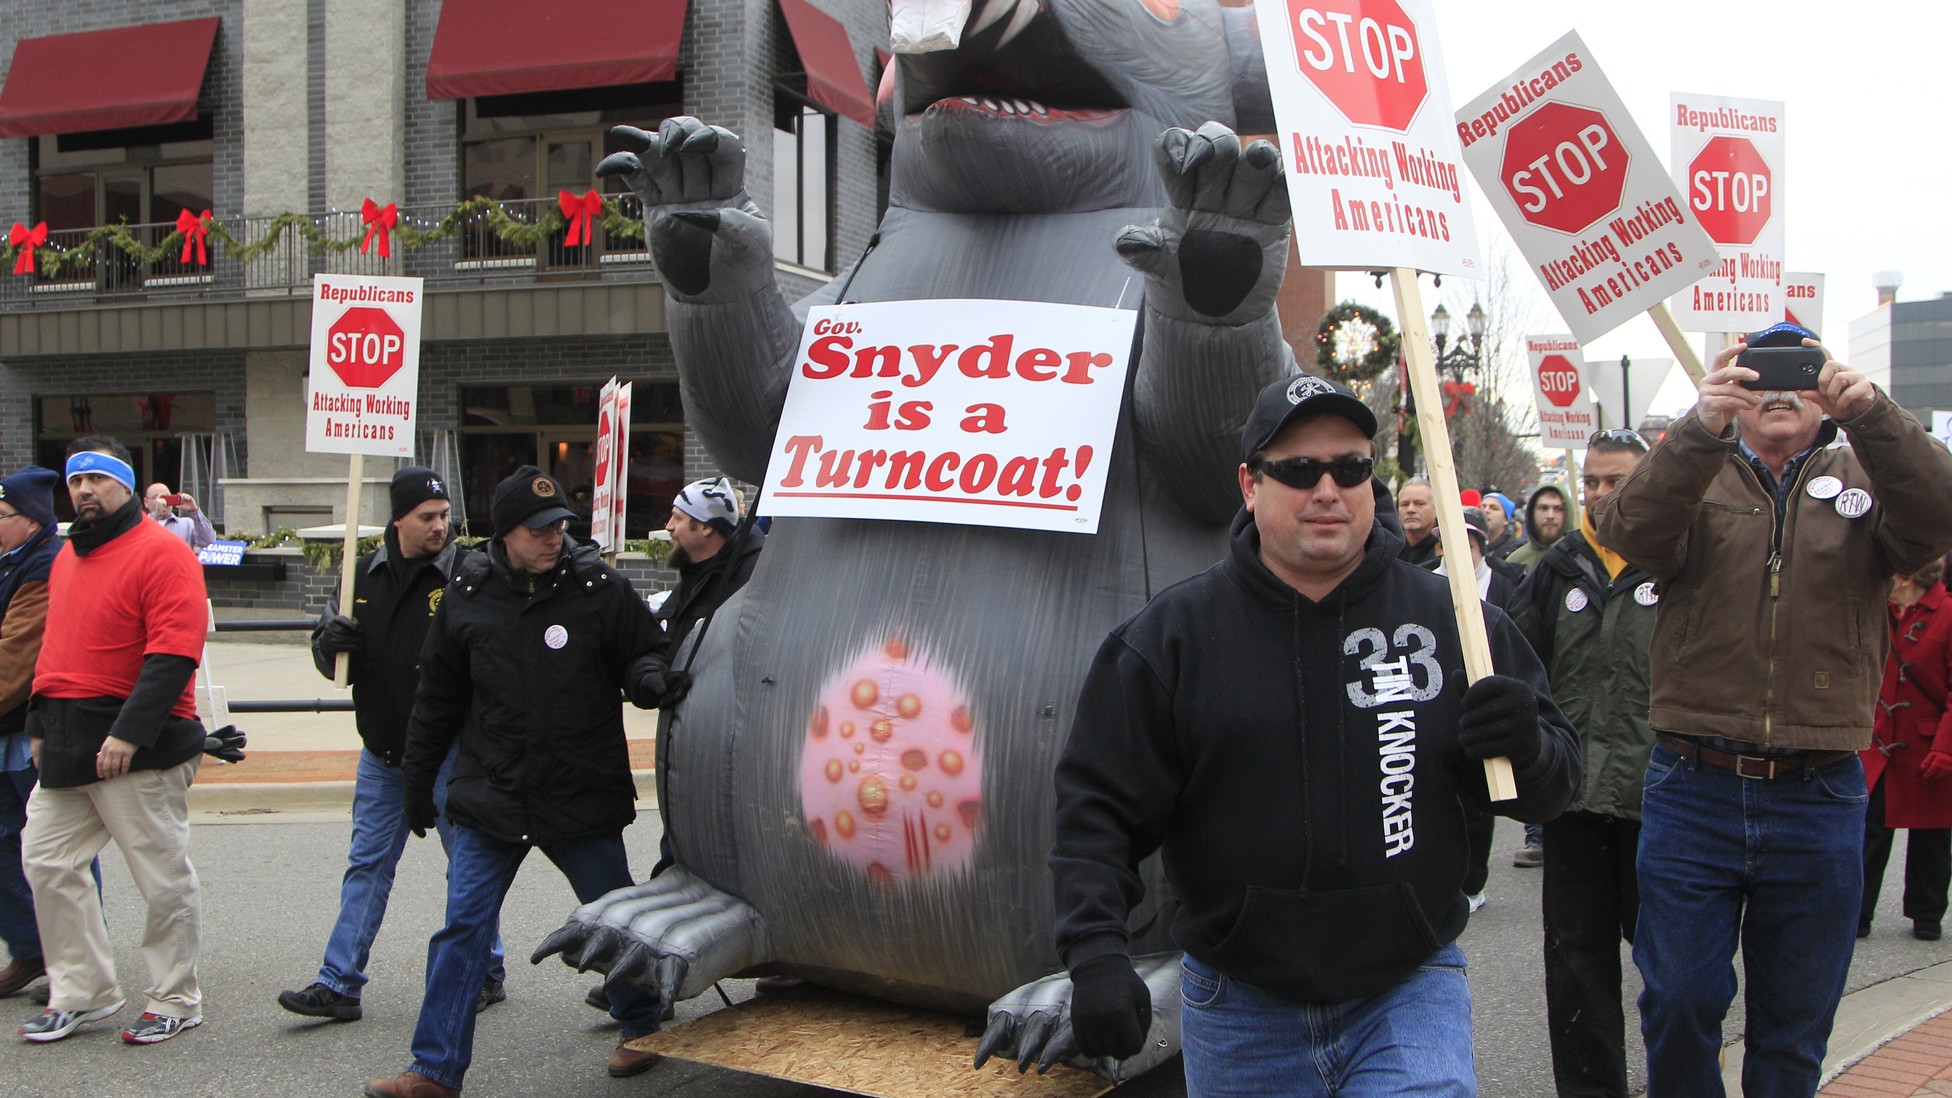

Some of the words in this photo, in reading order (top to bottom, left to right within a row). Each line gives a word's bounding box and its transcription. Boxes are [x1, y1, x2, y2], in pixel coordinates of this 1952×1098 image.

[1298, 8, 1414, 84] STOP
[1456, 52, 1583, 148] Republicans
[1677, 103, 1777, 133] Republicans
[1292, 132, 1394, 190] Attacking
[1392, 141, 1461, 204] Working
[1512, 123, 1609, 213] STOP
[1693, 170, 1768, 213] STOP
[1331, 188, 1450, 243] Americans
[1539, 239, 1621, 292] Attacking
[1608, 195, 1685, 248] Working
[1576, 241, 1683, 315] Americans
[1740, 252, 1780, 287] Working
[320, 283, 414, 304] Republicans
[1693, 285, 1769, 312] Americans
[330, 331, 400, 365] STOP
[813, 318, 862, 336] Gov.
[1528, 340, 1578, 353] Republicans
[802, 334, 1113, 388] Snyder
[1540, 371, 1577, 392] STOP
[313, 391, 362, 418] Attacking
[366, 394, 410, 421] Working
[863, 390, 933, 430] is
[959, 403, 1008, 434] a
[325, 418, 394, 440] Americans
[780, 435, 1093, 502] Turncoat!
[1840, 492, 1867, 514] RTW
[199, 552, 240, 565] POWER
[204, 544, 243, 553] EAMSTER
[1343, 623, 1444, 709] 33
[1371, 655, 1413, 703] TIN
[1376, 710, 1416, 859] KNOCKER
